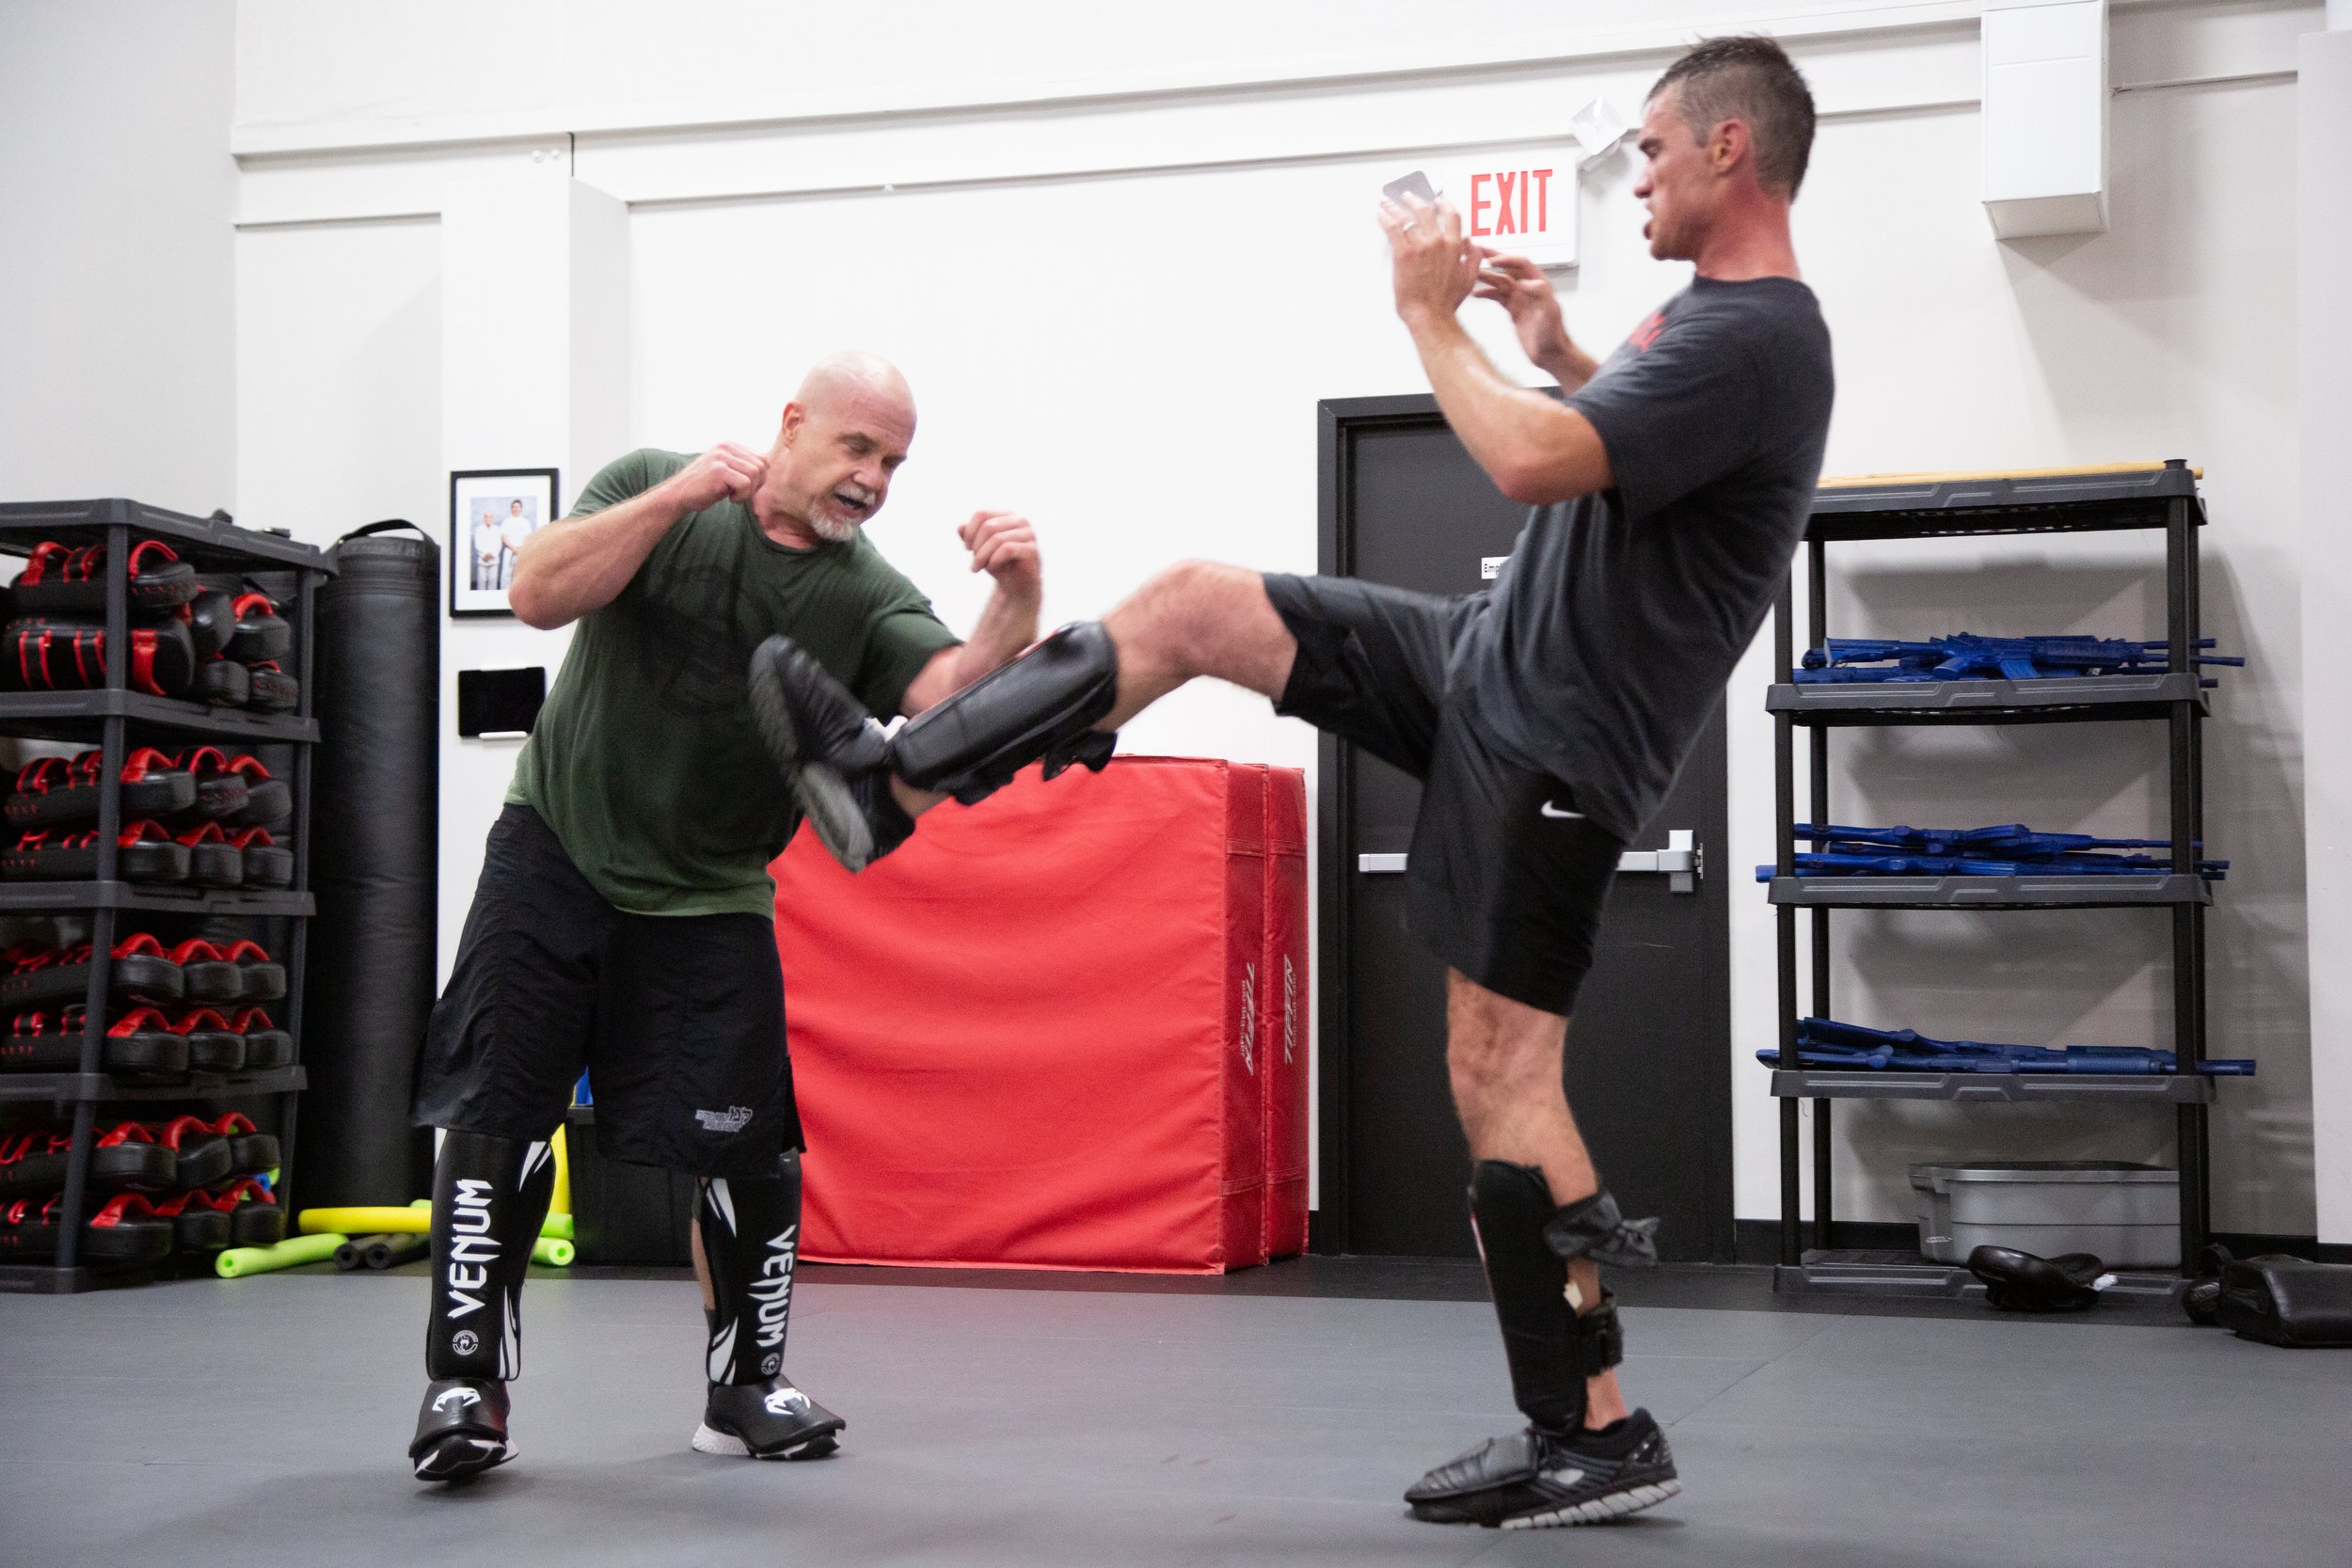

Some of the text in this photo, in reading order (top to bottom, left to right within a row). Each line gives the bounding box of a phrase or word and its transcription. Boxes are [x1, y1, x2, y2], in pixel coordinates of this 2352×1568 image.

[1470, 169, 1552, 237] EXIT
[447, 1179, 502, 1319] VENUM
[747, 1224, 797, 1347] VENUM
